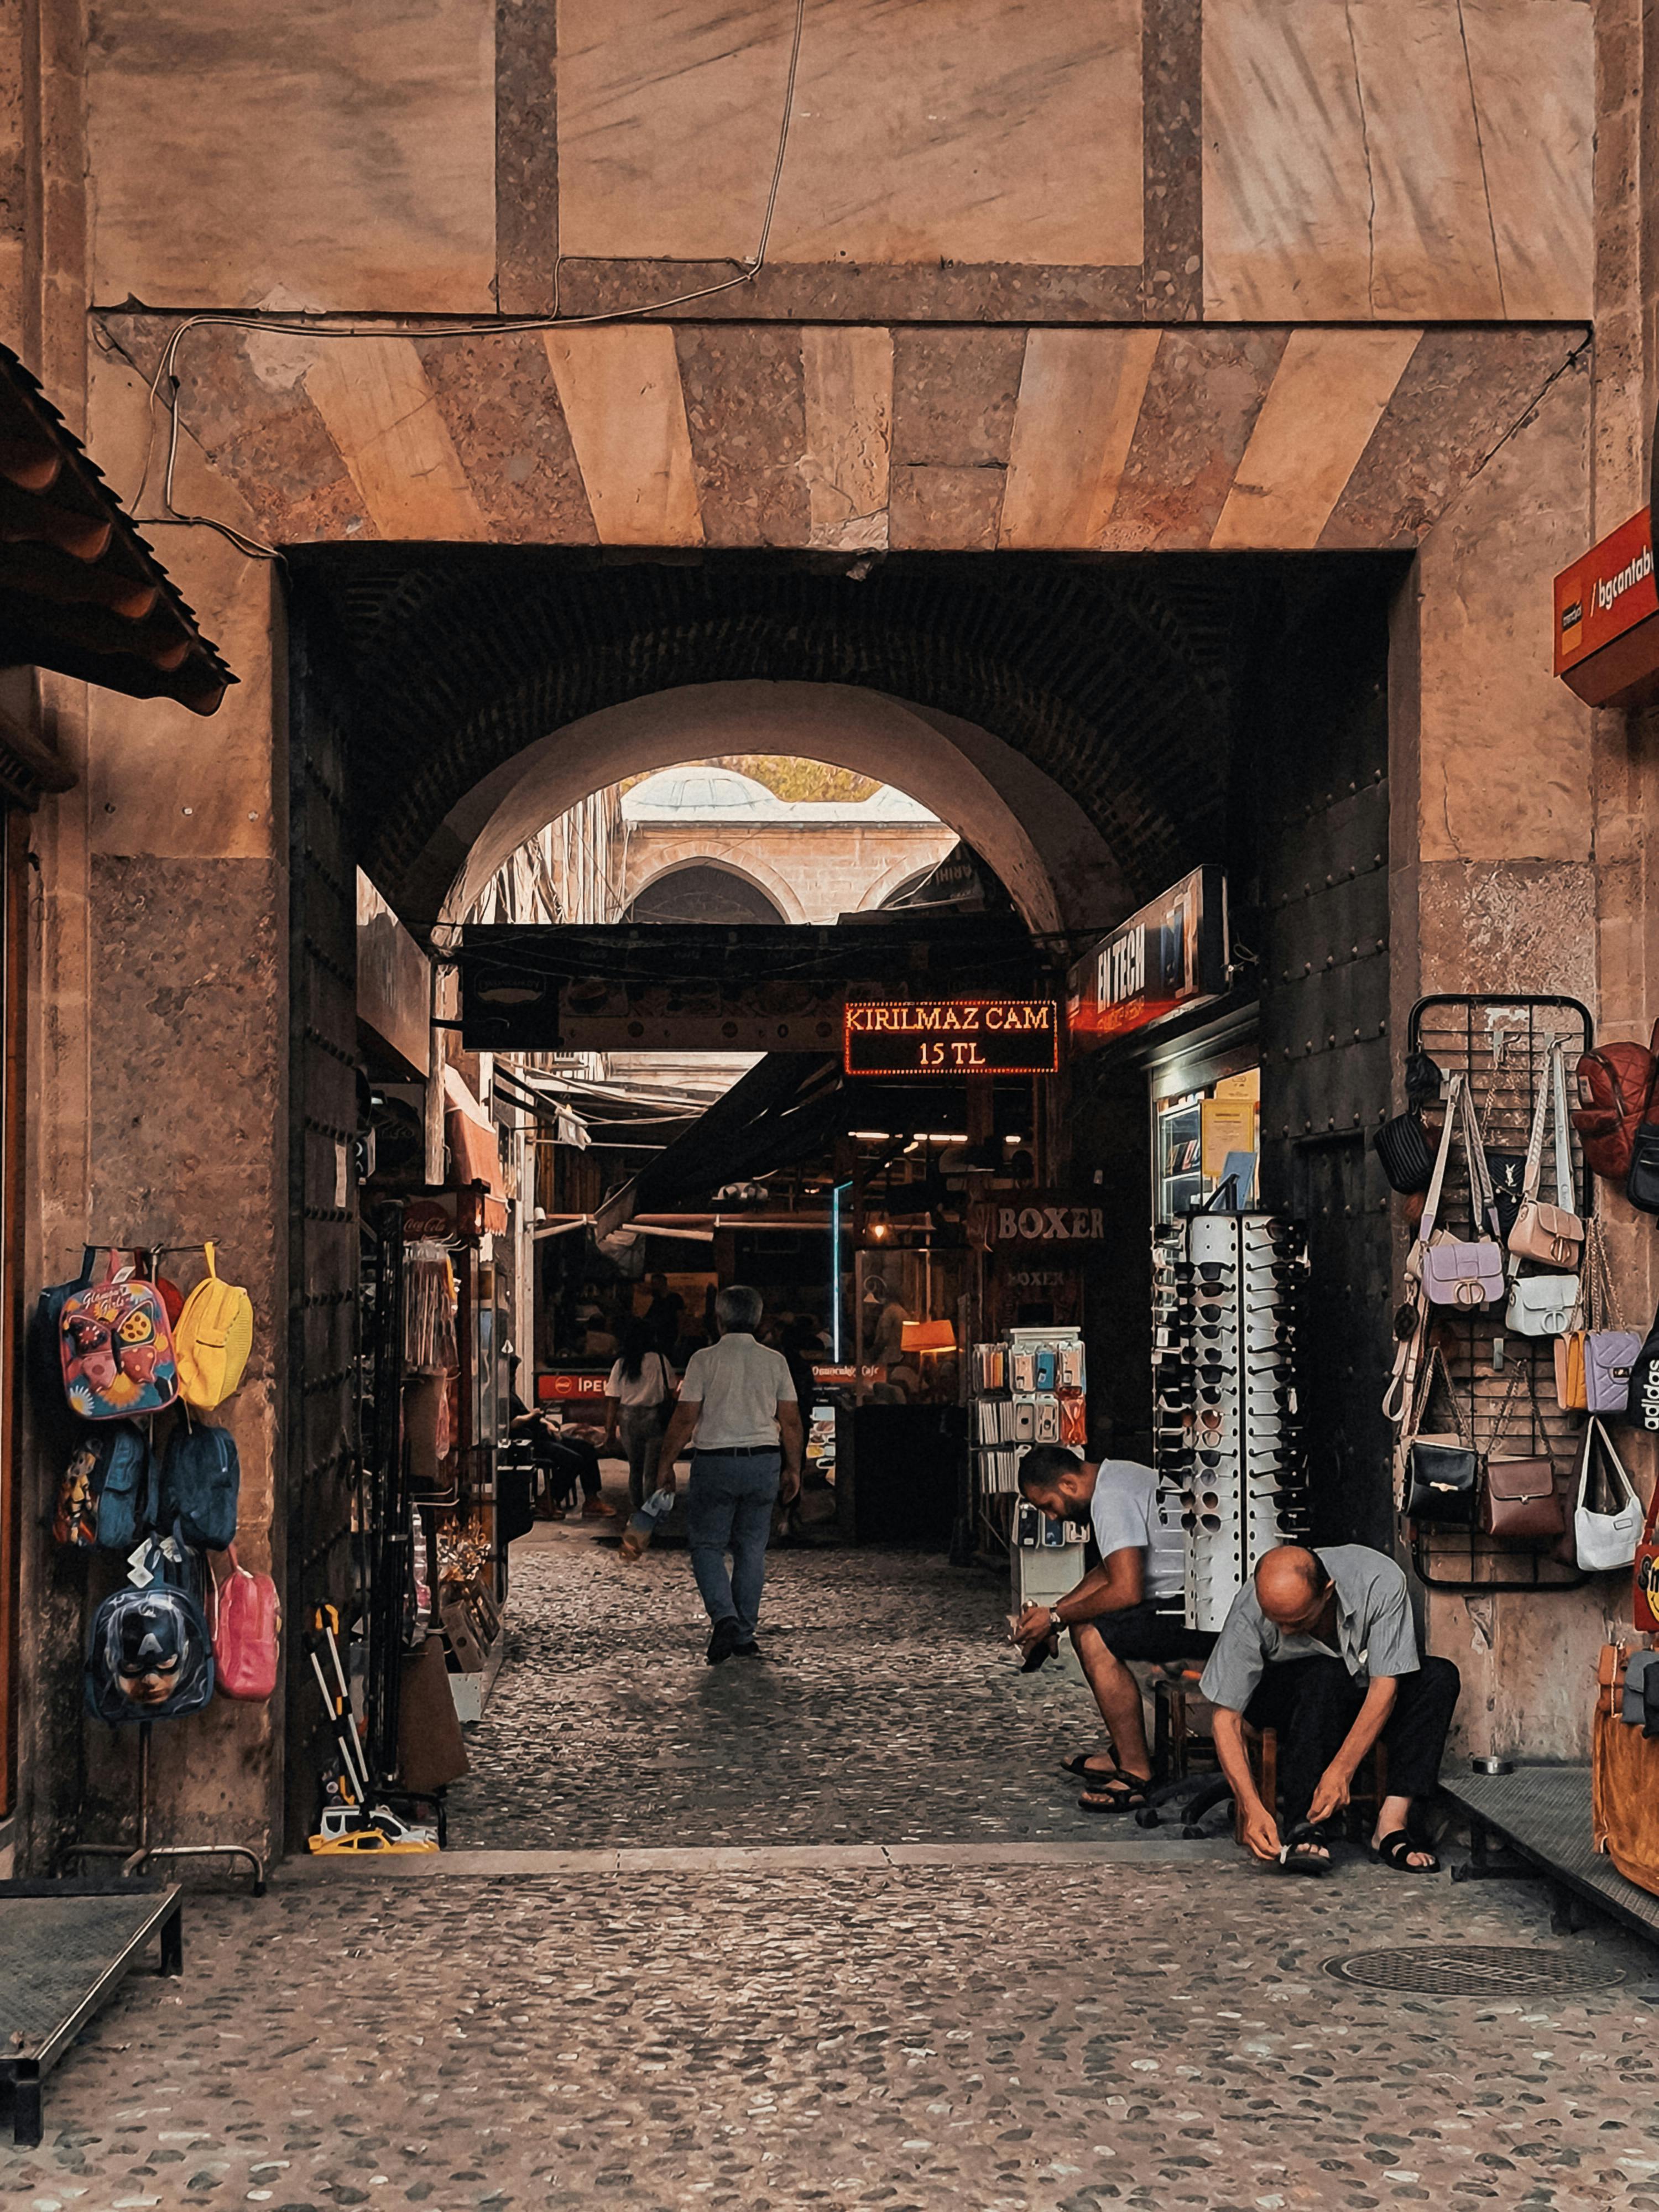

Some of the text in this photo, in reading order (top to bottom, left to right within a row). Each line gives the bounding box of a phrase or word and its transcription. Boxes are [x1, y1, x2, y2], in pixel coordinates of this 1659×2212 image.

[1113, 922, 1146, 1004] TECH
[847, 1007, 1049, 1030] KIRILMAZ CAM
[920, 1042, 986, 1065] 15 TL
[998, 1207, 1105, 1239] BOXER
